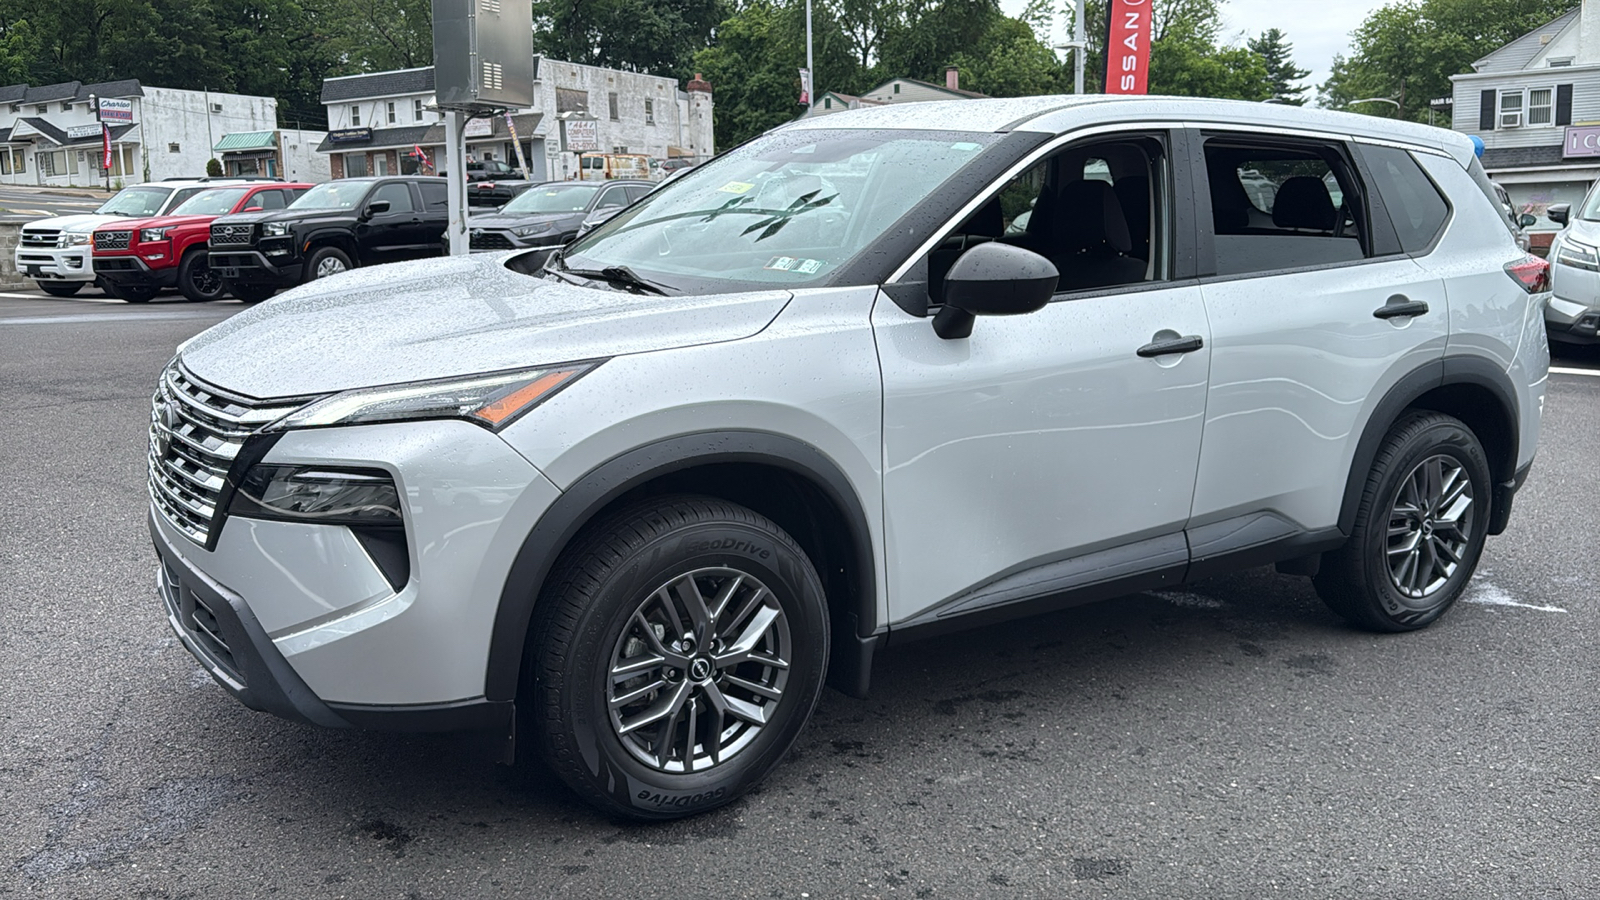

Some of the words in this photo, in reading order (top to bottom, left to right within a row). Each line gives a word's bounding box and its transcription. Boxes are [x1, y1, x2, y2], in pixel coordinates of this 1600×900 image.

[567, 128, 595, 136] COMPUTERS
[686, 538, 770, 559] GeoDrive
[637, 786, 727, 807] GeoDrive
